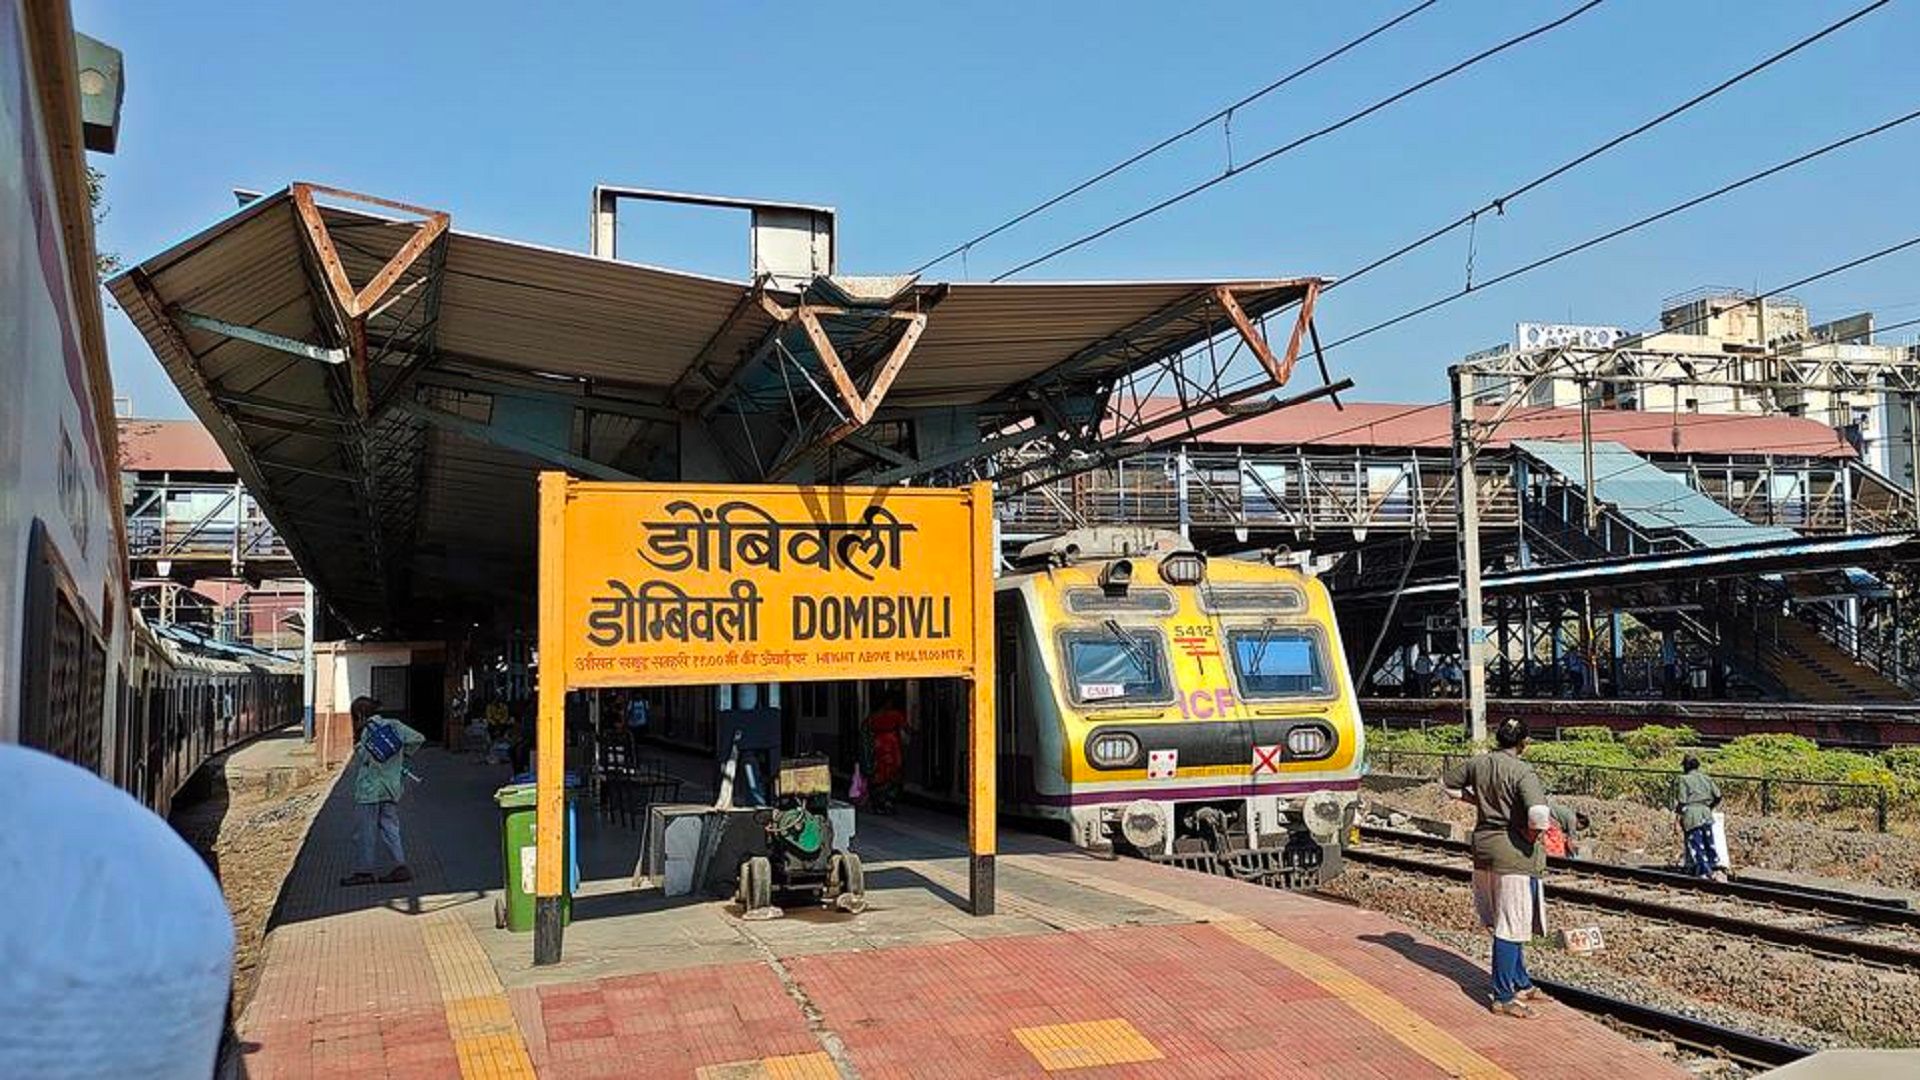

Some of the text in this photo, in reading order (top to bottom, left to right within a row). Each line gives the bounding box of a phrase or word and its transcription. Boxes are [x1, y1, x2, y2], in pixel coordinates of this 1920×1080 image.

[637, 499, 918, 582] डोंबिवली
[587, 579, 764, 647] डोम्बिवली
[792, 596, 951, 641] DOMBIVLI
[1174, 625, 1214, 637] 5412
[858, 650, 892, 663] ABOVE
[1179, 688, 1236, 719] ICF
